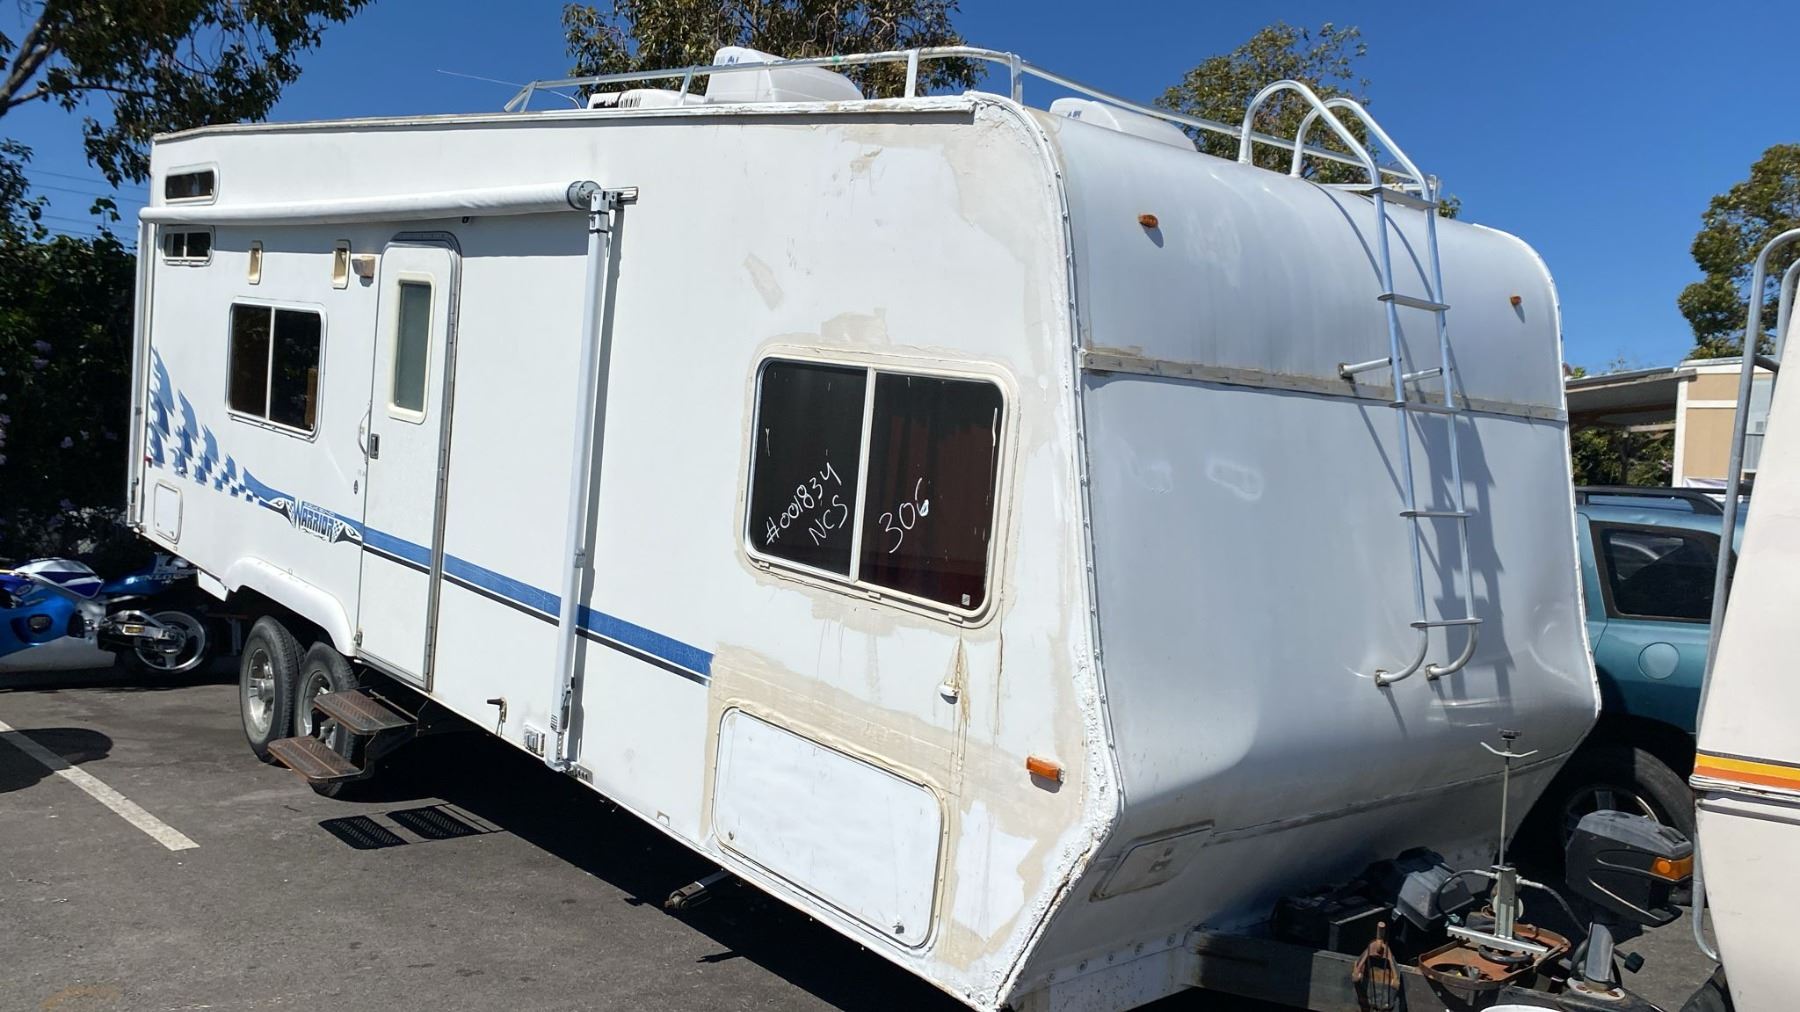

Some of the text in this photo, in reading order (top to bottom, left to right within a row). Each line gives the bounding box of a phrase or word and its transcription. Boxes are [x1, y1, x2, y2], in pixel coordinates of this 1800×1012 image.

[293, 499, 334, 543] WARRIOR
[766, 462, 842, 545] #001834
[809, 495, 848, 546] NCS
[880, 478, 929, 554] 306
